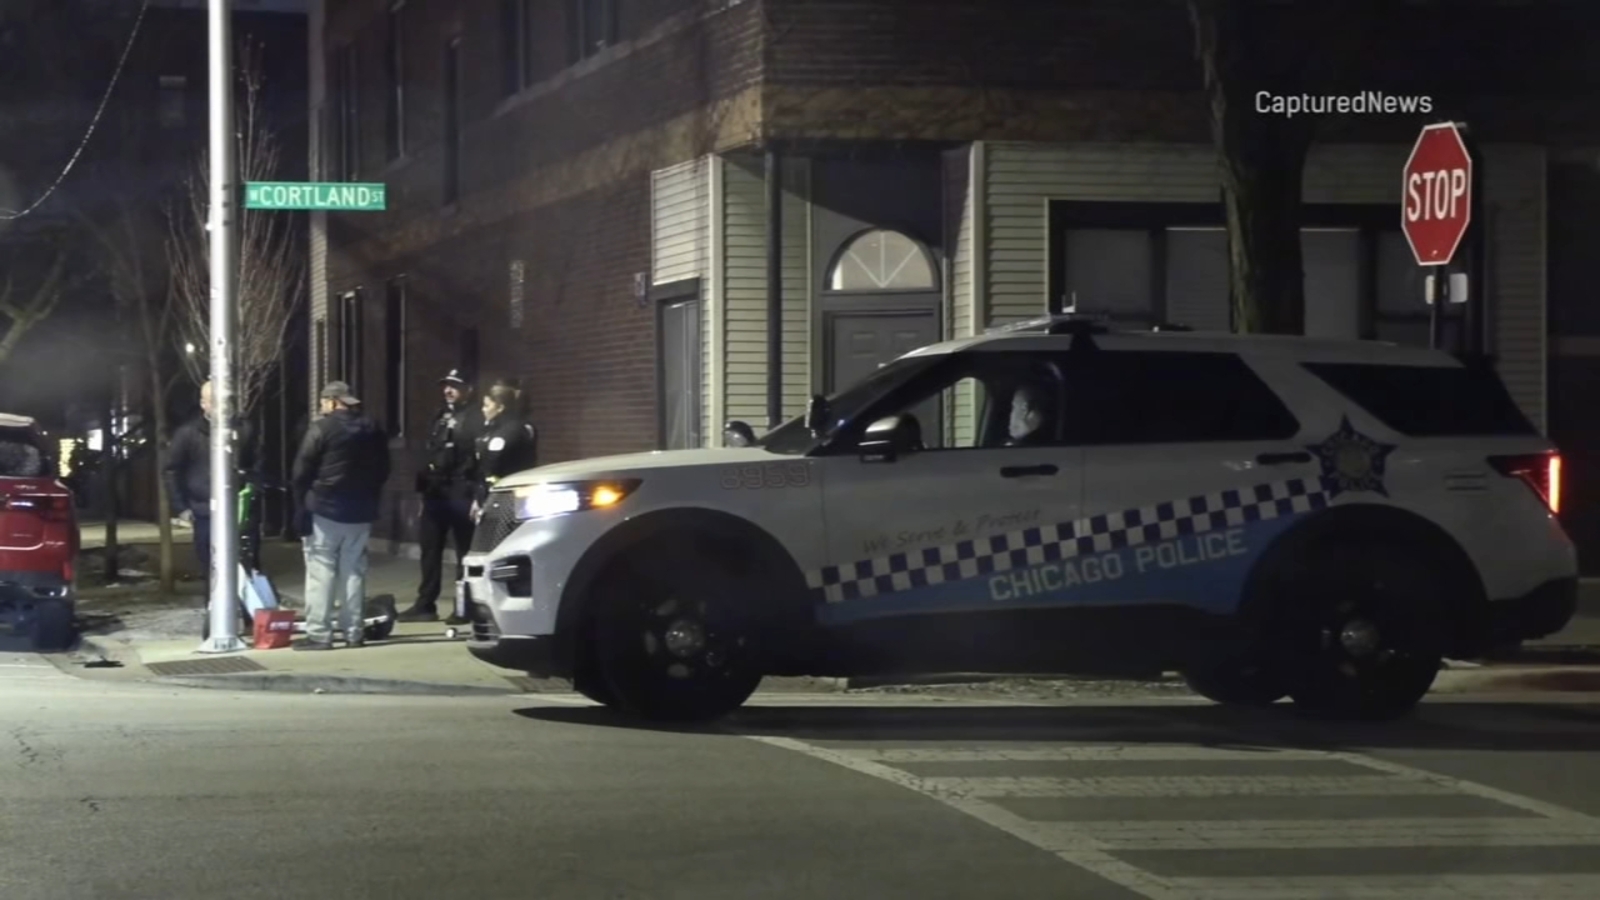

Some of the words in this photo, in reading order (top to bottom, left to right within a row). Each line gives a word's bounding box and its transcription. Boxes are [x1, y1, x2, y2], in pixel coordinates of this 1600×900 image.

[259, 186, 371, 207] CORTLAND
[371, 191, 385, 203] ST
[1407, 168, 1466, 222] STOP
[720, 462, 811, 491] 8959
[862, 534, 890, 553] We
[988, 553, 1123, 600] CHICAGO
[1136, 529, 1247, 572] POLICE
